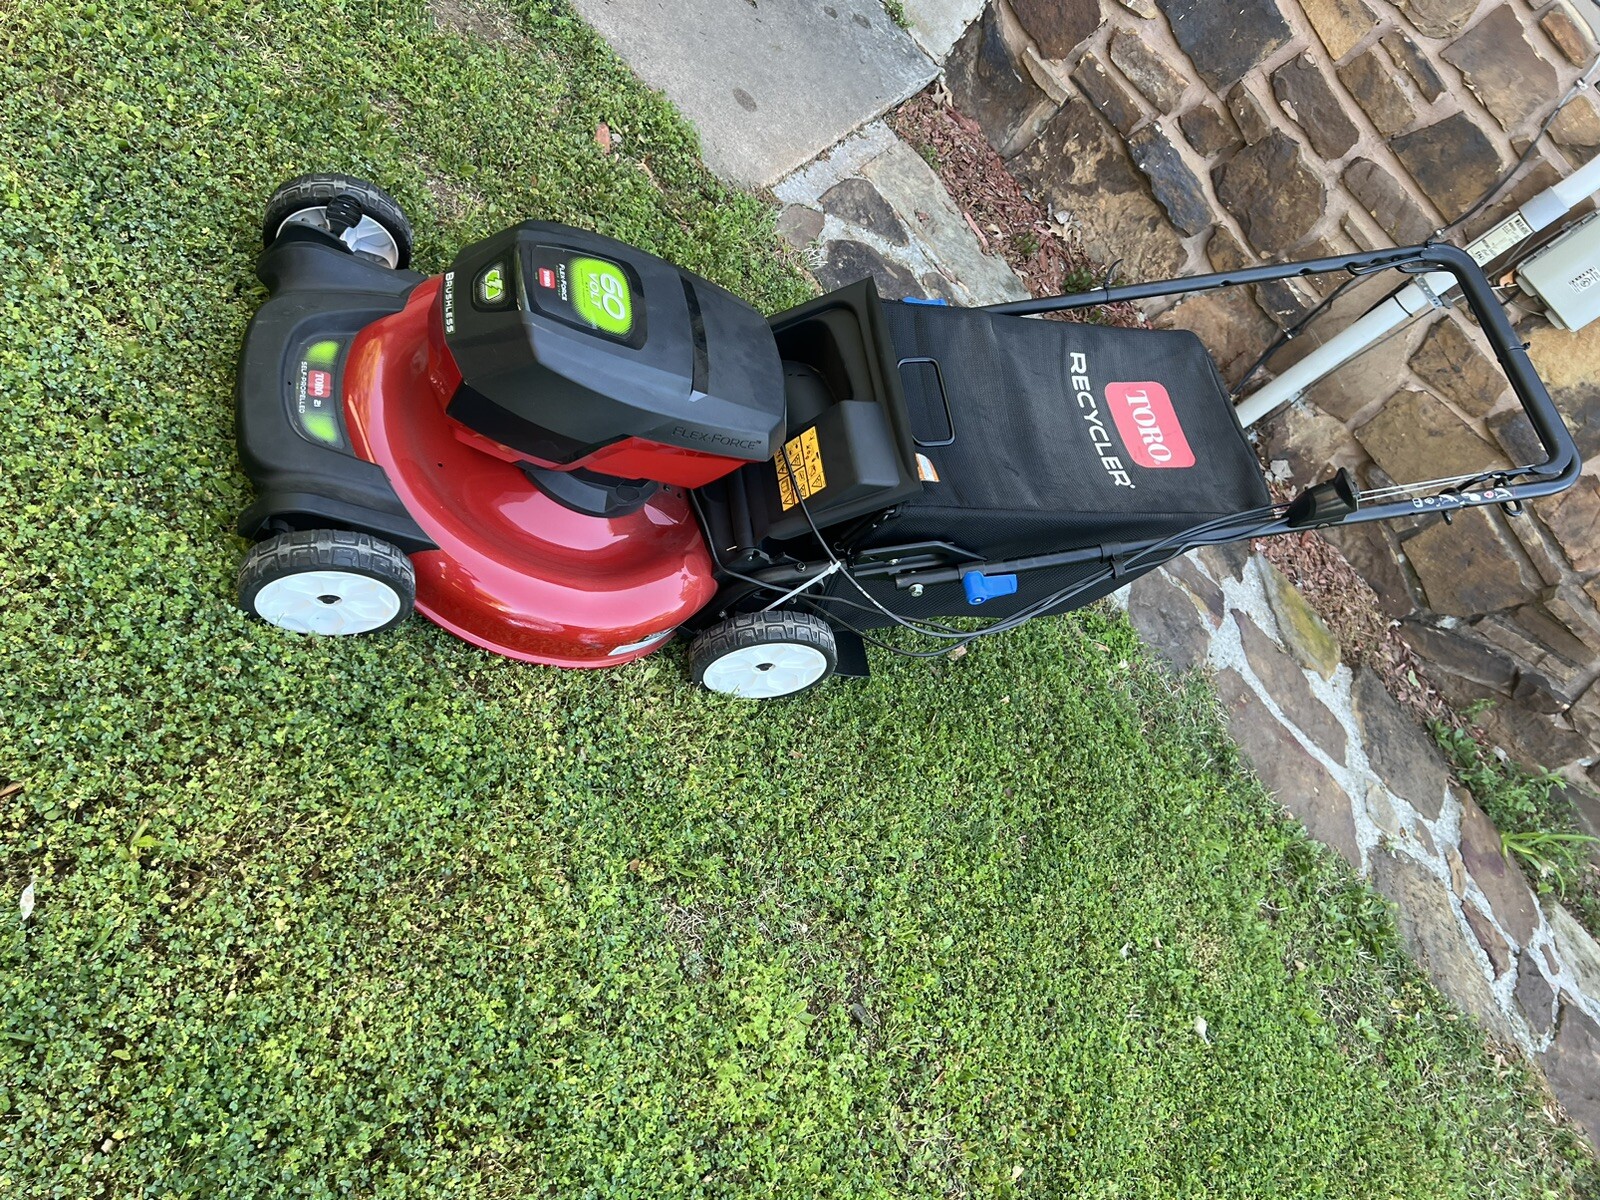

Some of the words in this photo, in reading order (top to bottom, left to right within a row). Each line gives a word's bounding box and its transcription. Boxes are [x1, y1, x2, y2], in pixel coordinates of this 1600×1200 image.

[445, 272, 455, 333] BRUSHLESS
[588, 273, 602, 310] VOLT
[600, 273, 625, 320] 60
[298, 361, 307, 414] SELF-PROPELLED
[314, 373, 324, 396] TORO
[1069, 352, 1132, 487] RECYCLER
[1125, 389, 1172, 463] TORO
